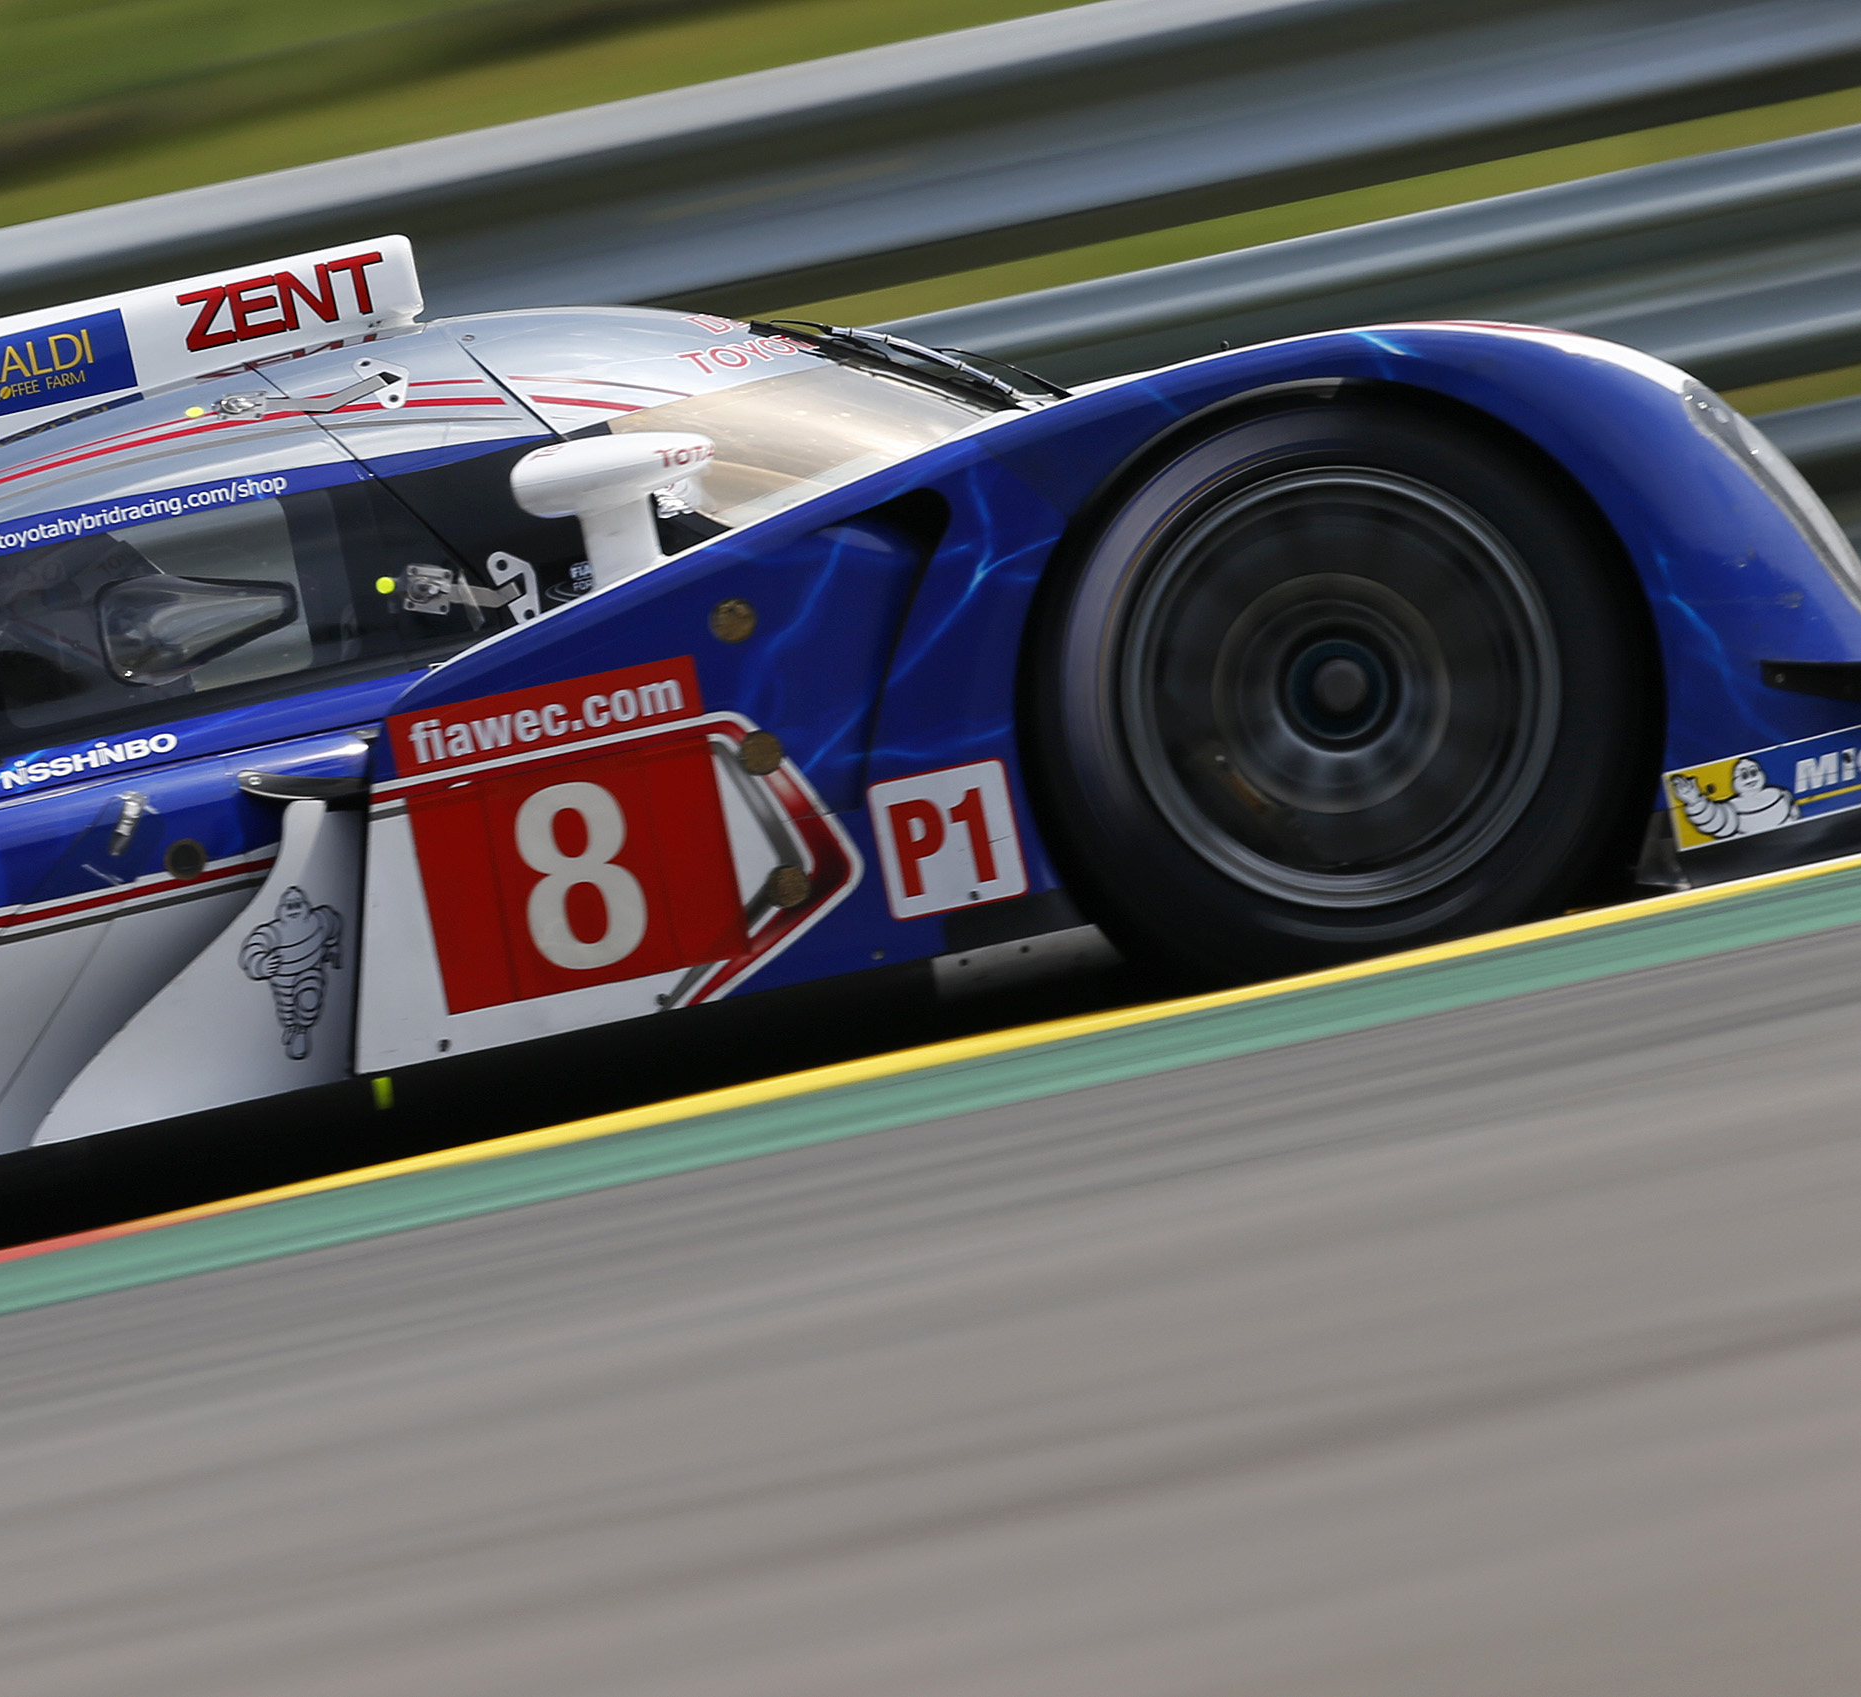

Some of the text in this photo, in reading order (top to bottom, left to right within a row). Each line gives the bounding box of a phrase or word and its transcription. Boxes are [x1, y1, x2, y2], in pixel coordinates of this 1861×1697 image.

[176, 252, 383, 352] ZENT
[45, 369, 86, 390] FARM
[676, 334, 820, 376] TOYOT
[409, 678, 685, 765] fiawec.com
[514, 781, 648, 971] 8
[886, 787, 999, 898] P1
